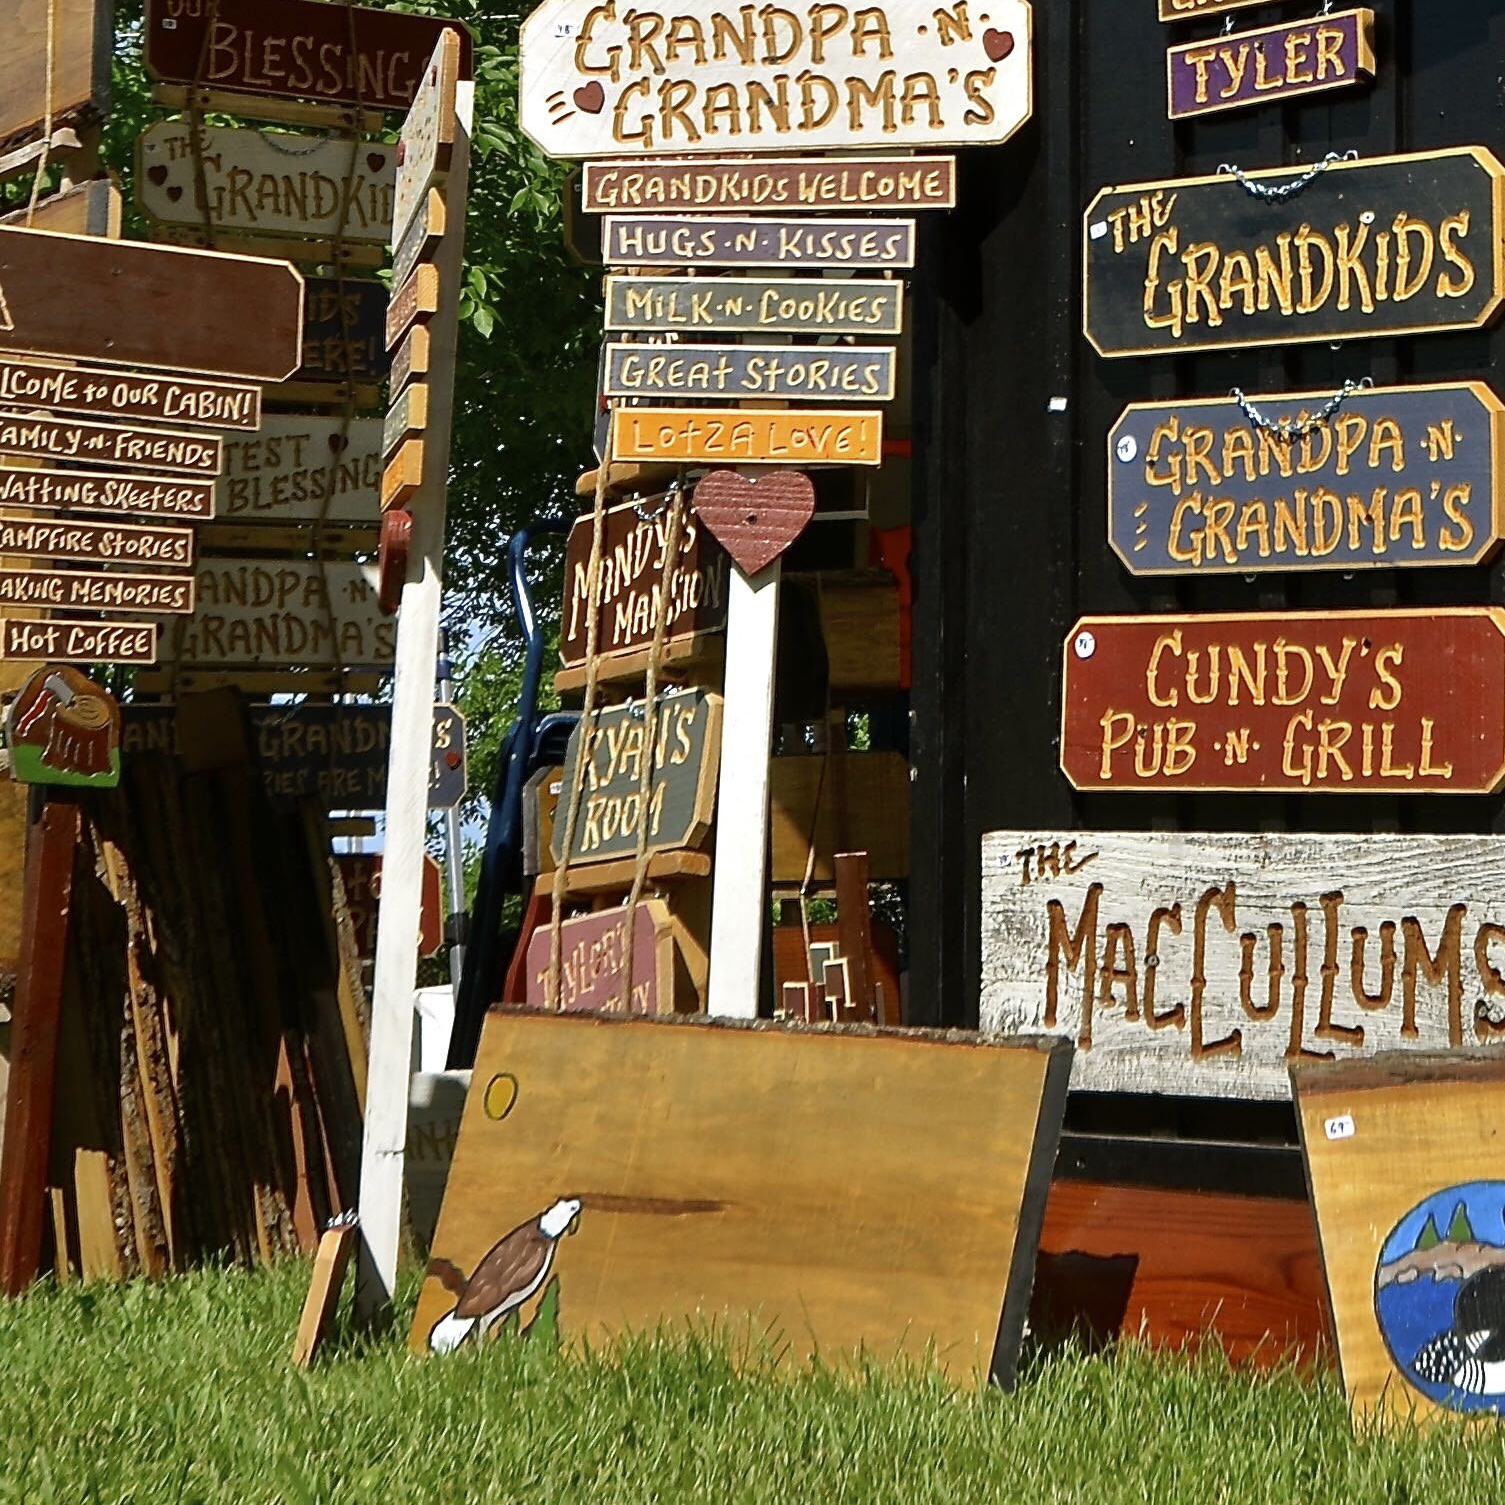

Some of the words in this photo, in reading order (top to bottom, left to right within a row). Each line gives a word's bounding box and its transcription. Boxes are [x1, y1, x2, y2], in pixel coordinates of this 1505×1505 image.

[208, 22, 430, 100] BLESSING
[575, 0, 893, 83] GRANDPA
[1184, 25, 1347, 105] TYLER
[613, 67, 997, 149] GRANDMA'S
[193, 154, 394, 229] GRANDKID
[595, 170, 787, 207] GRANDKIDS
[799, 168, 943, 203] WELCOME
[618, 227, 716, 257] HUGS
[779, 228, 902, 261] KISSES
[1108, 190, 1177, 253] THE
[1143, 210, 1475, 338] GRANDKIDS
[625, 288, 714, 324] MILK
[757, 292, 886, 325] COOKIES
[0, 367, 78, 403] LCOME
[112, 383, 159, 407] OUR
[164, 386, 250, 424] CABIN!
[620, 355, 733, 389] GREAT
[741, 358, 881, 394] STORIES
[0, 422, 82, 455] AMILY
[114, 433, 214, 468] FRIENDS
[632, 418, 755, 455] LOTZA
[767, 419, 868, 456] LOVE!
[1145, 409, 1404, 495] GRANDPA
[100, 481, 205, 512] SKEETERS
[1168, 478, 1475, 566] GRANDMA'S
[0, 524, 94, 552] AMPFIRE
[99, 532, 187, 561] STORIES
[0, 576, 64, 602] AKING
[71, 578, 186, 608] MEMORIES
[196, 567, 327, 608] ANDPA
[10, 625, 60, 654] HOT
[67, 627, 148, 656] COFFEE
[1146, 629, 1404, 710] CUNDY'S
[1100, 706, 1197, 779] PUB
[1281, 707, 1454, 785] GRILL
[1015, 840, 1098, 885] THE
